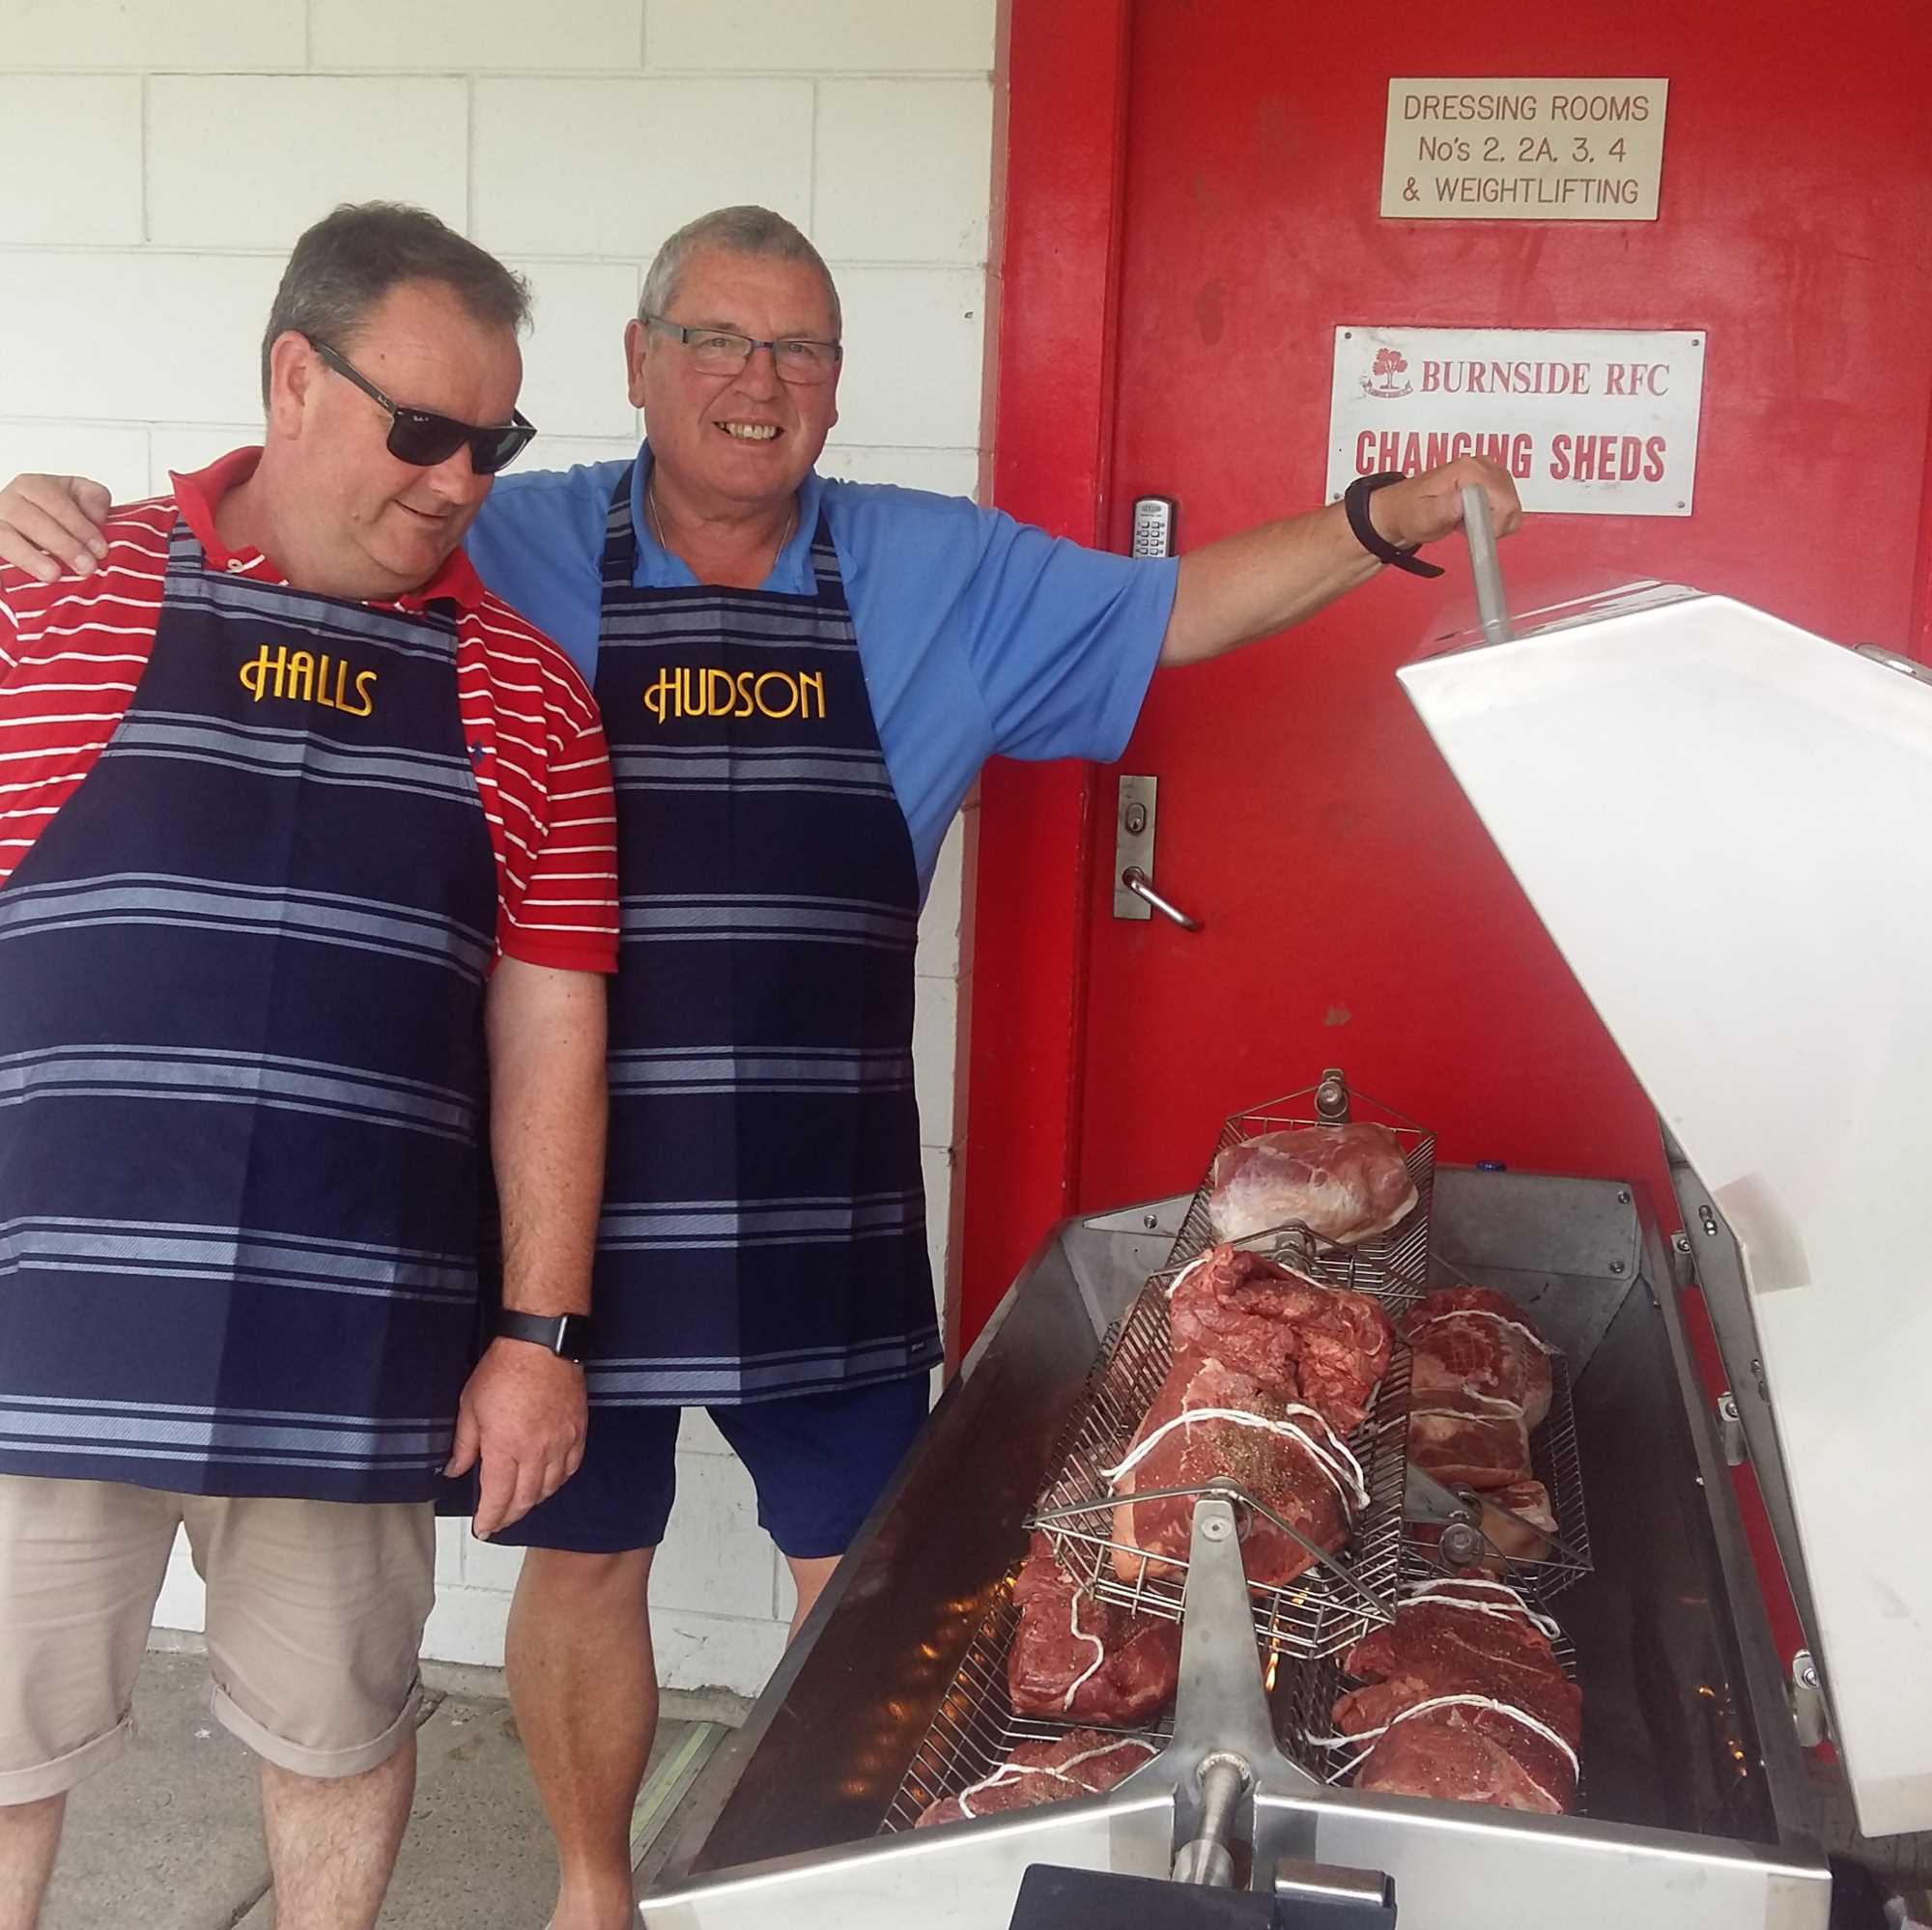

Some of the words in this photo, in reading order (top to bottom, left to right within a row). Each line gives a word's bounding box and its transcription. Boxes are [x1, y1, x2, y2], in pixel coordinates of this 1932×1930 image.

[1404, 95, 1538, 121] DRESSING
[1550, 96, 1649, 121] ROOMS
[1419, 136, 1470, 161] No's
[1608, 138, 1627, 162] 4
[1403, 177, 1421, 202] &
[1435, 178, 1639, 205] WEIGHTLIFTING
[1421, 360, 1591, 394] BURNSIDE
[1604, 363, 1670, 396] RFC
[1549, 434, 1666, 482] SHEDS
[240, 644, 378, 717] HALLS
[643, 667, 826, 724] HUDSON
